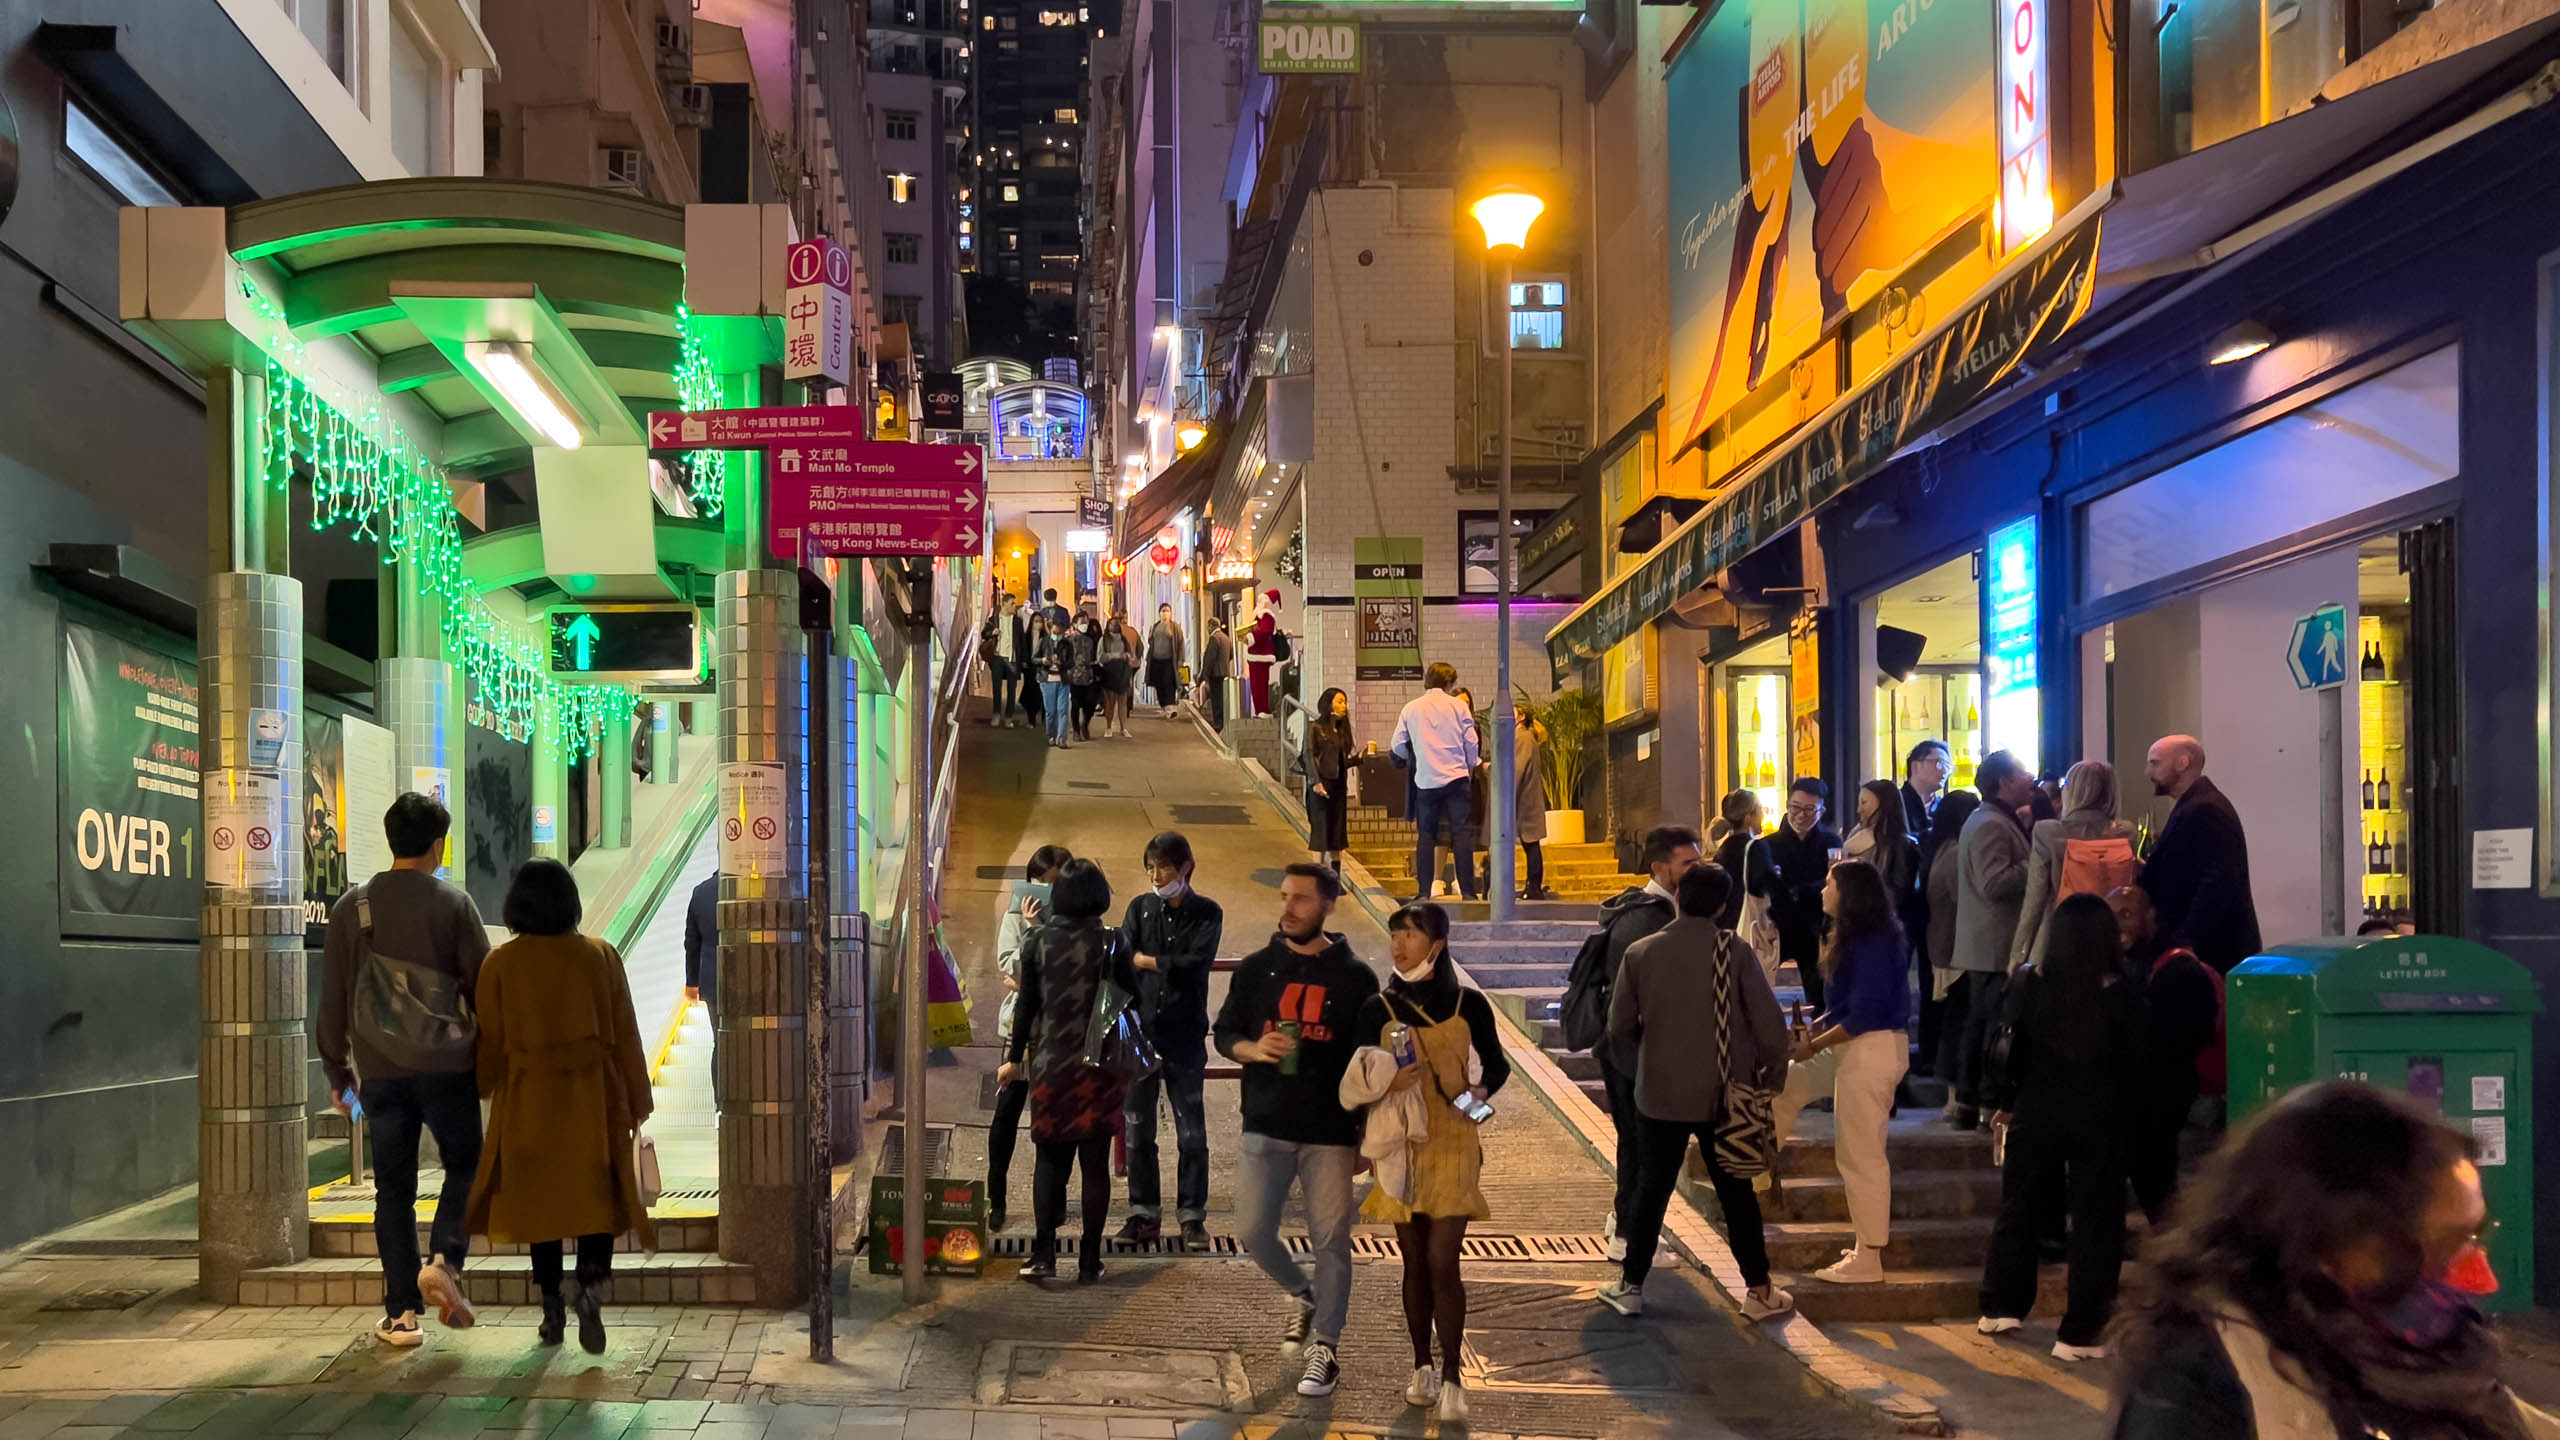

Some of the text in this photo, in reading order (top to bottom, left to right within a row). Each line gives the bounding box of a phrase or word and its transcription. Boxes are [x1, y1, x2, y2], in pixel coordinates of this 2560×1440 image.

[1263, 25, 1355, 60] POAD
[1264, 61, 1306, 69] SMARTER
[1757, 55, 1781, 87] STELLA
[1757, 71, 1782, 102] ARTOIS
[1784, 101, 1817, 158] THE
[1821, 53, 1861, 120] LIFE
[789, 294, 819, 368] 中環
[830, 296, 842, 370] Central
[1952, 271, 2086, 385] STELLA AOIS
[928, 393, 960, 404] CAPO
[711, 416, 739, 430] 大館
[711, 431, 725, 441] Tai
[727, 430, 752, 440] Kwun
[808, 449, 848, 462] 文武廟
[808, 462, 896, 475] Man Mo Temple
[809, 501, 836, 511] PMQ
[1084, 499, 1110, 513] SHOP
[1763, 486, 1799, 521] STELLA
[842, 538, 873, 551] Kong
[875, 539, 940, 550] News-Expo
[1372, 567, 1405, 577] OPEN
[77, 807, 171, 878] OVER
[180, 827, 193, 879] 1
[2380, 968, 2447, 979] LETTER BOX
[880, 1190, 933, 1201] TOMO
